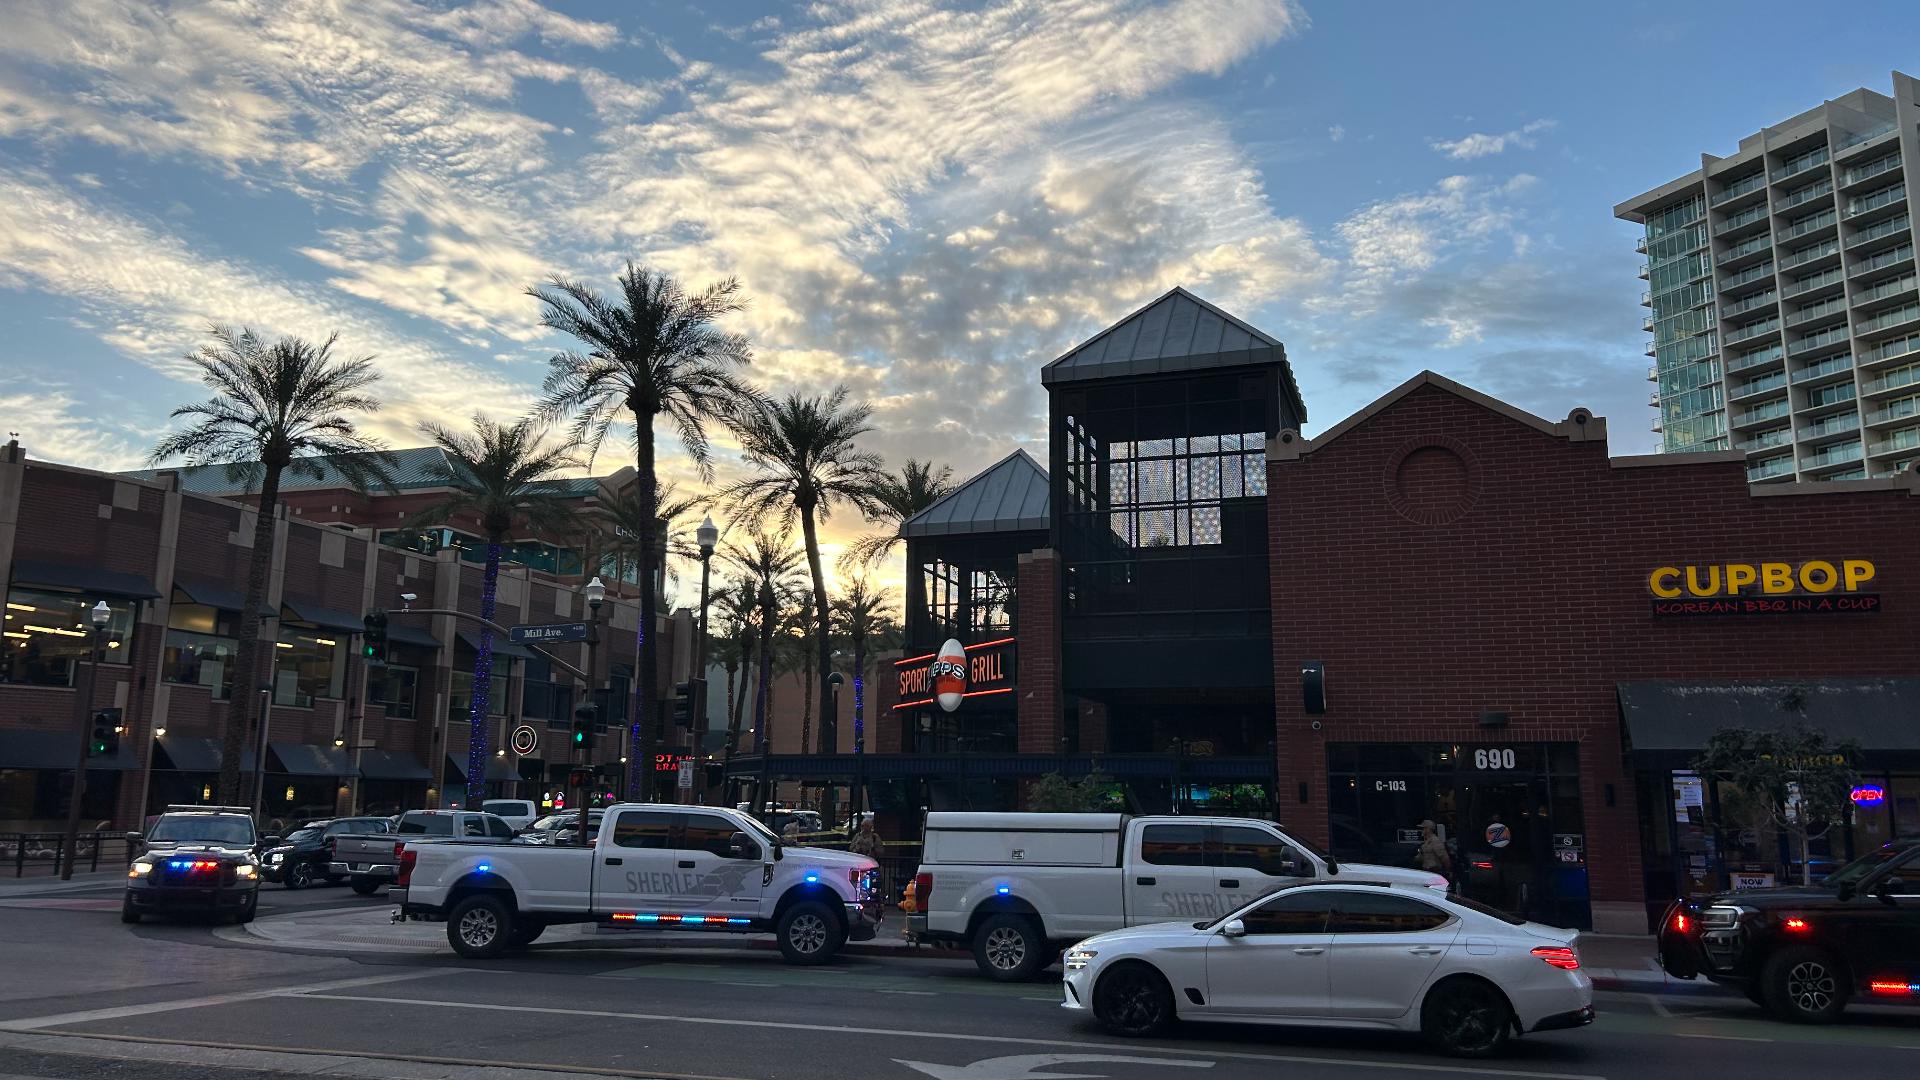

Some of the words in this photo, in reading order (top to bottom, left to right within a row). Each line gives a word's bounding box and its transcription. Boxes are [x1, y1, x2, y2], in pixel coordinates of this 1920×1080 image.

[1649, 559, 1876, 598] CUPBOP
[1654, 600, 1738, 615] KOREAN
[1744, 599, 1788, 612] BBQ
[1792, 599, 1812, 611] IN
[1816, 598, 1833, 611] A
[1836, 597, 1879, 611] CUP
[523, 629, 542, 638] Mill
[544, 628, 564, 637] Ave.
[900, 667, 928, 696] SPORT
[971, 653, 1004, 683] GRILL
[1474, 748, 1516, 770] 690
[1375, 780, 1407, 792] C-103
[1851, 789, 1883, 801] OPEN
[1741, 878, 1763, 886] NOW
